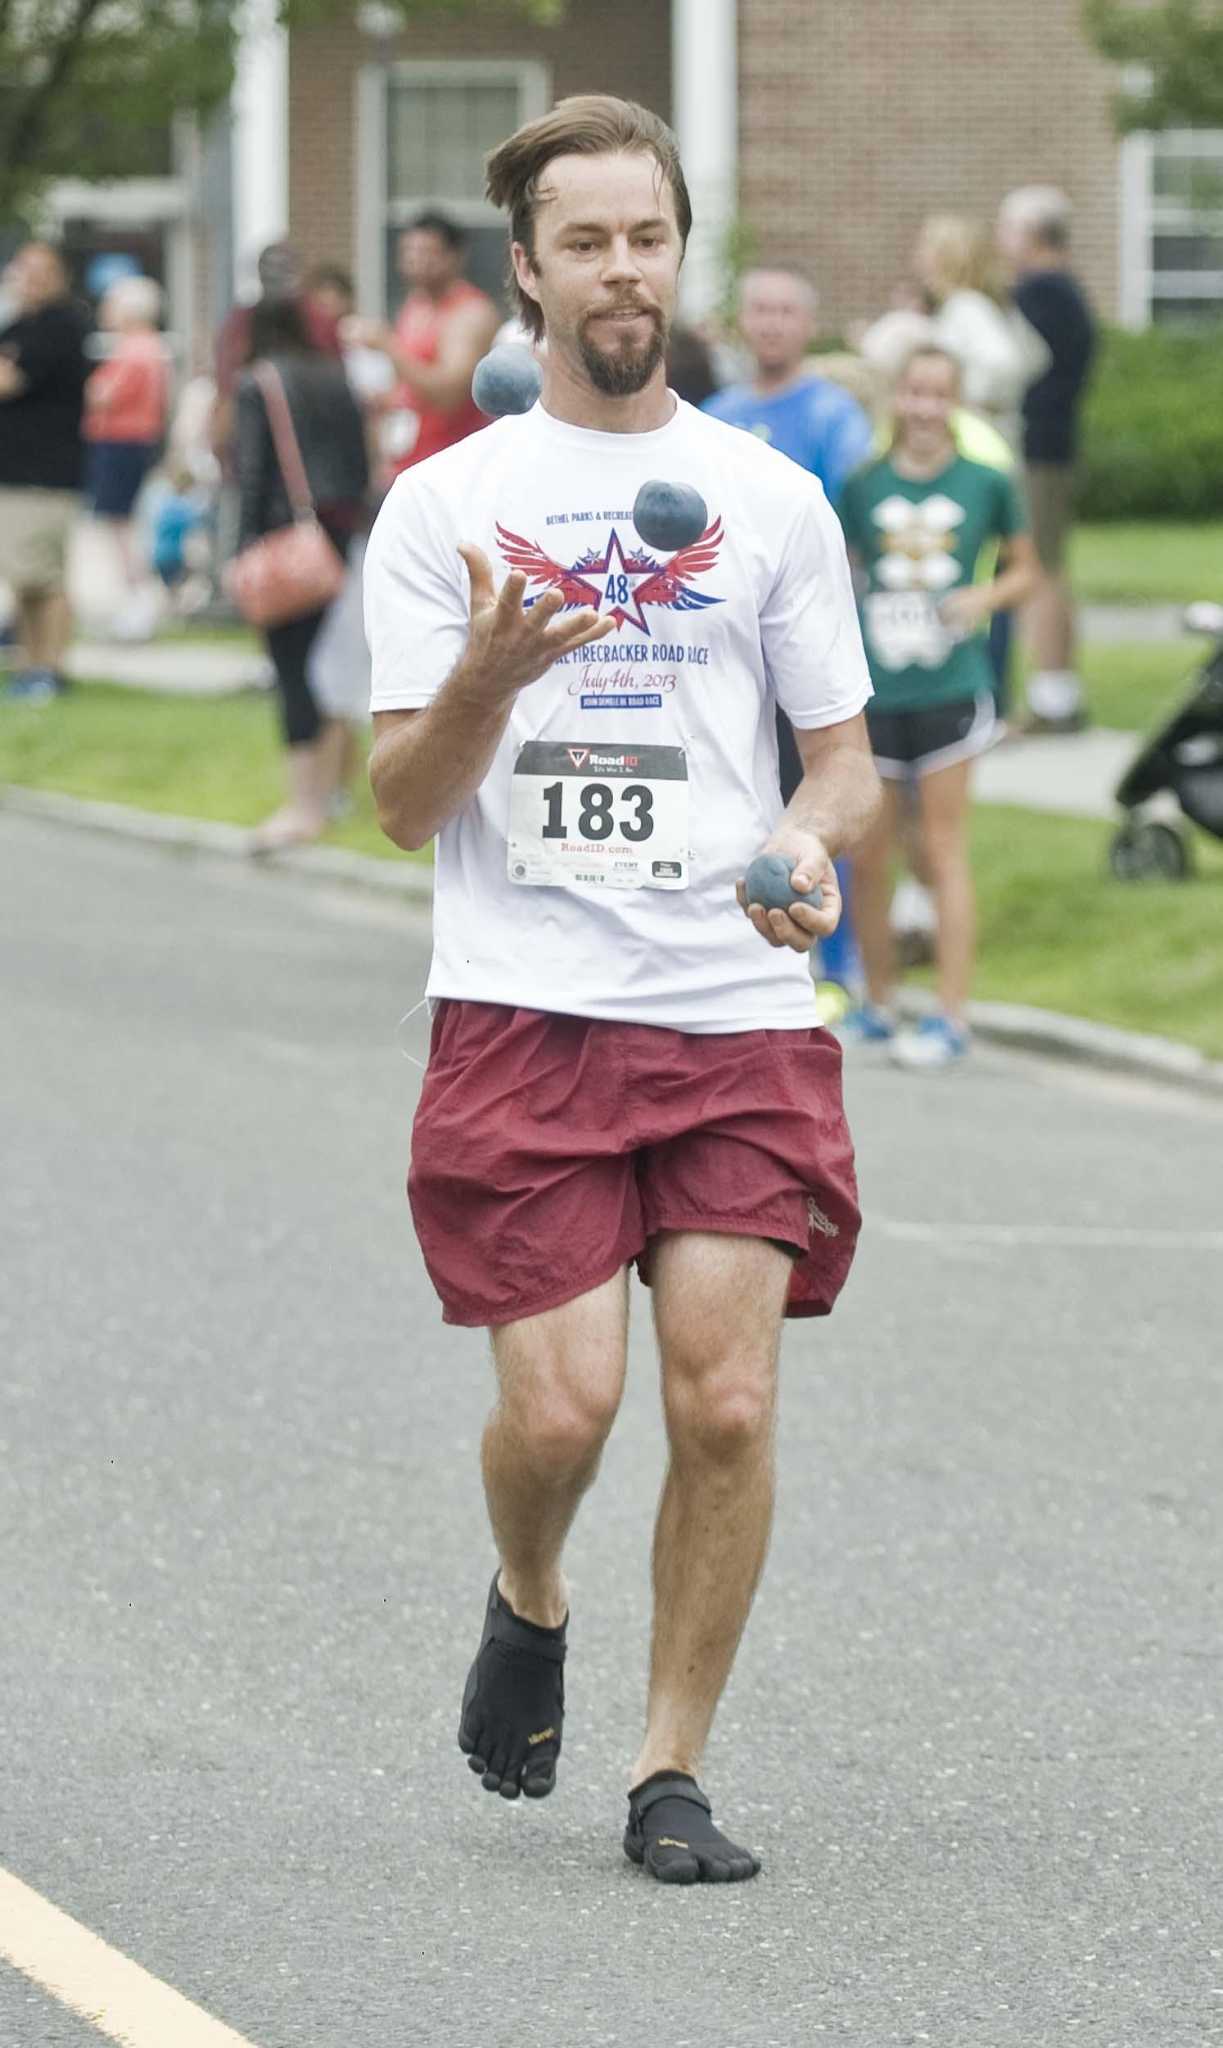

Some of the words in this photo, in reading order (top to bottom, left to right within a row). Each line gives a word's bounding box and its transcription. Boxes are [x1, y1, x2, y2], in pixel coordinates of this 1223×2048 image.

[546, 513, 569, 525] BETHEL
[571, 511, 594, 521] PARKS
[595, 511, 602, 520] &
[573, 644, 648, 664] FIRECRACKER
[652, 644, 684, 663] ROAD
[687, 646, 709, 665] RACE
[643, 673, 677, 693] 2013
[589, 754, 639, 766] RoadID
[542, 781, 654, 842] 183
[560, 843, 634, 855] RoadID.com
